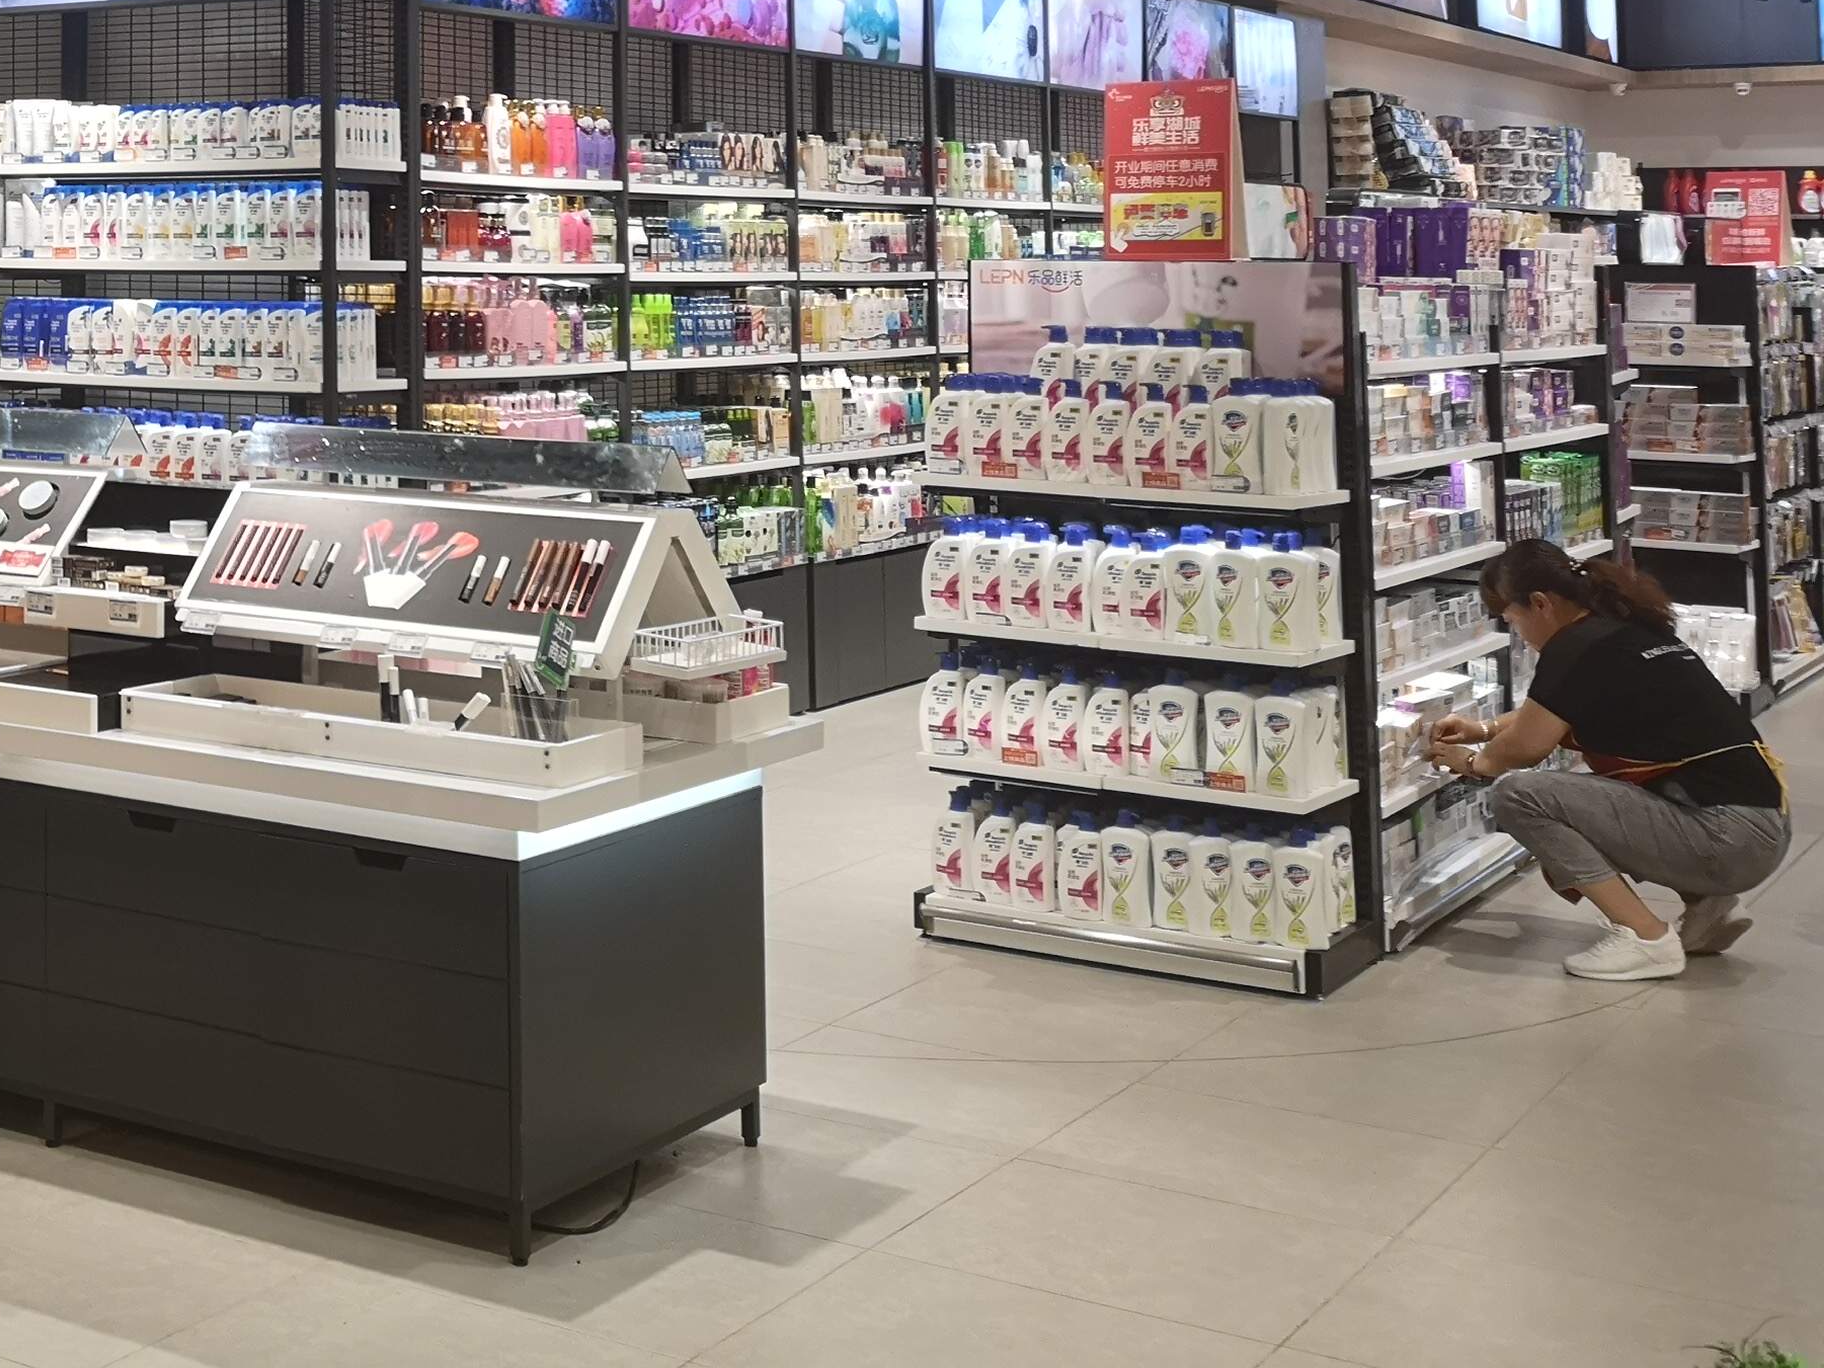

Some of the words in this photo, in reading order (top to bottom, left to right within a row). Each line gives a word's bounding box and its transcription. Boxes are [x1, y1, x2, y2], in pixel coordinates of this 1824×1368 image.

[980, 267, 1025, 285] LEPN
[1027, 269, 1083, 293] 乐品鲜活
